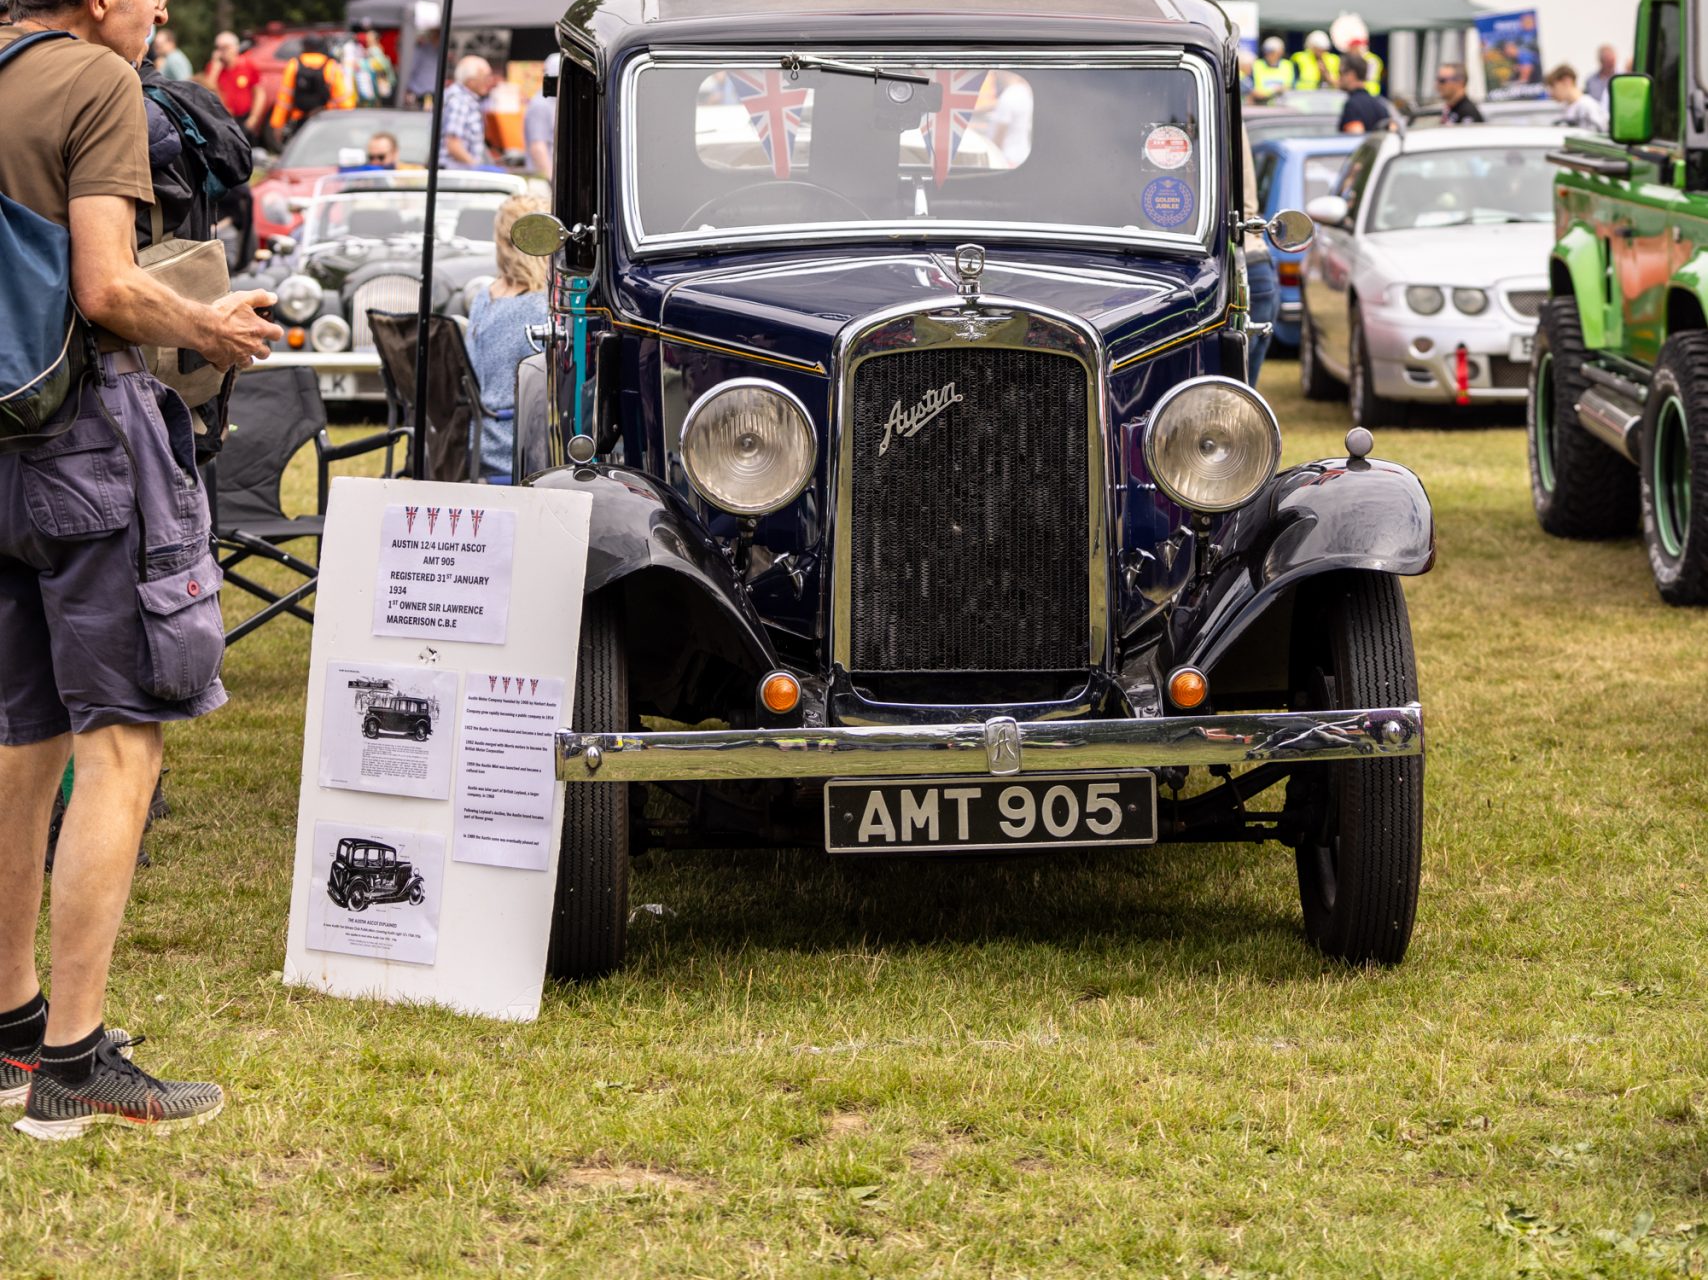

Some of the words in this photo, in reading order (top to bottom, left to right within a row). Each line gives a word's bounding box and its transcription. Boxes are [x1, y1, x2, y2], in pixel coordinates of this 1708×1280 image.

[878, 381, 964, 457] Austin
[392, 539, 419, 549] AUSTIN
[437, 542, 460, 552] LIGHT
[461, 544, 486, 553] ASCOT
[423, 556, 440, 565] AMT
[441, 558, 455, 566] 905
[390, 571, 435, 582] REGISTERED
[453, 575, 489, 585] JANUARY
[389, 586, 407, 595] 1934
[399, 601, 426, 611] OWNER
[428, 603, 441, 612] SIR
[442, 604, 484, 615] LAWRENCE
[387, 615, 435, 627] MARGERISON
[858, 787, 982, 842] AMT
[998, 782, 1123, 838] 905
